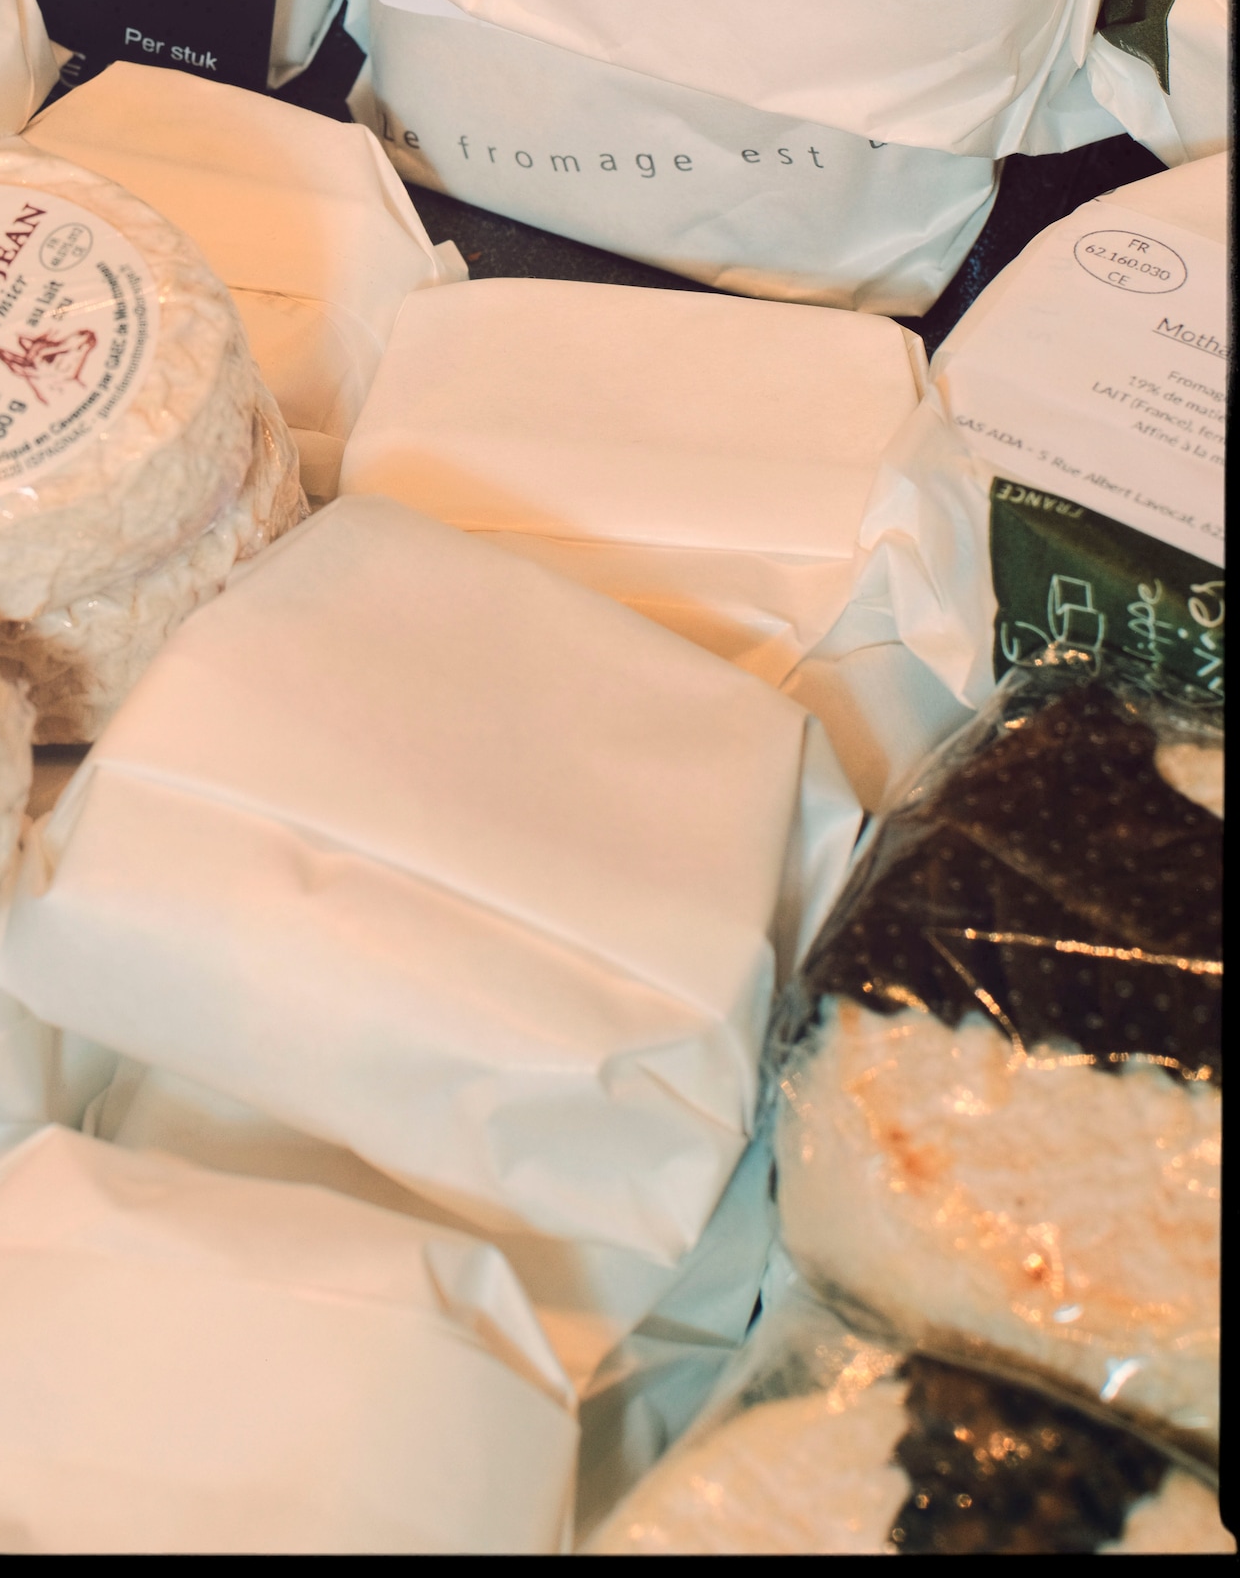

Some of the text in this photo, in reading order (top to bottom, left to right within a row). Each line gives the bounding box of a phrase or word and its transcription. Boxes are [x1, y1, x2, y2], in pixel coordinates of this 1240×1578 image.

[124, 27, 218, 71] Per stuk
[458, 135, 694, 180] fromage
[740, 144, 825, 170] est
[1084, 243, 1171, 282] 62.160.030
[1127, 238, 1151, 254] FR
[1107, 270, 1131, 287] CE
[1092, 381, 1131, 405] LAIT
[987, 426, 1023, 451] ADA
[1038, 449, 1048, 461] 5
[1051, 454, 1081, 477] Rue
[1082, 472, 1133, 498] Albert
[995, 483, 1085, 518] FRANCE
